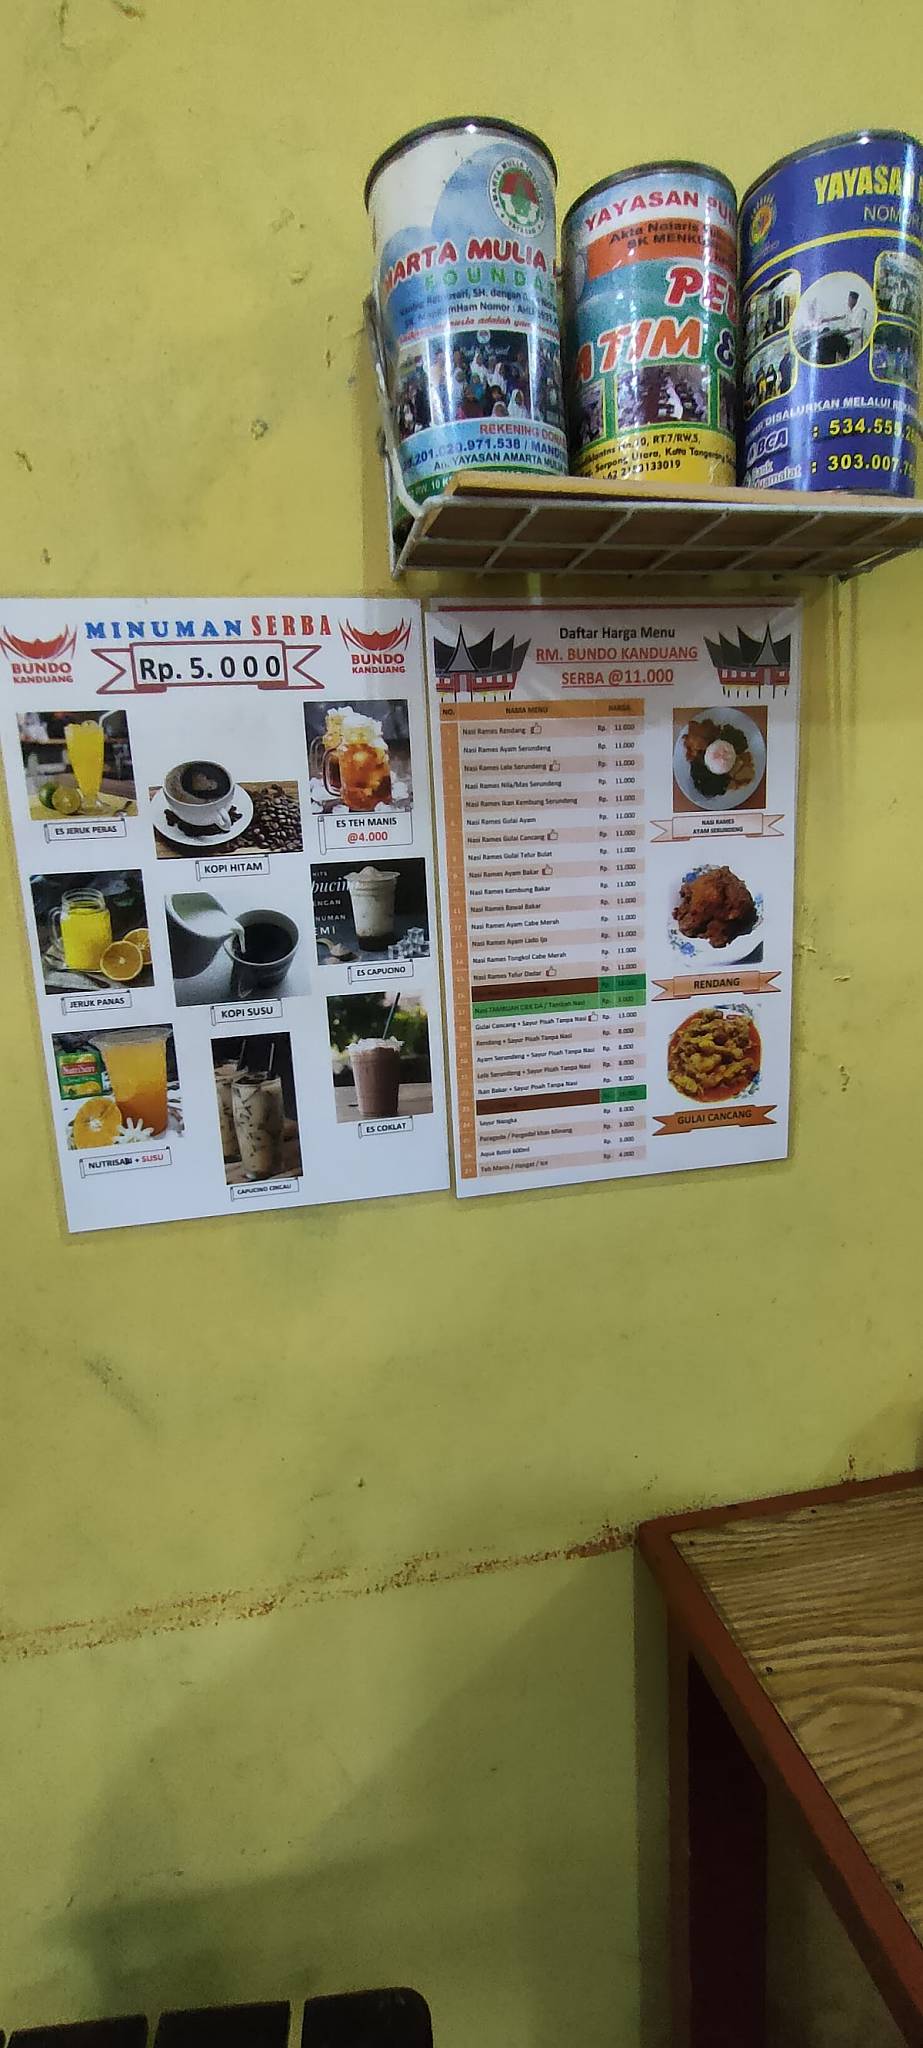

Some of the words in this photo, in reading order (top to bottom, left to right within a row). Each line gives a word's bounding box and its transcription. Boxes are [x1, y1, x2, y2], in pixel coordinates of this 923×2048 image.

[814, 166, 914, 204] YAYASA
[585, 190, 699, 231] YAYASAN
[610, 225, 643, 244] Akta
[648, 222, 699, 232] Notaris
[468, 238, 546, 272] MULIA
[480, 302, 510, 311] Nomor
[765, 399, 840, 428] DISALURKAN
[843, 397, 891, 407] MELALUI
[480, 424, 540, 437] REKENING
[757, 427, 788, 456] BCA
[452, 452, 500, 464] YAYASAN
[503, 453, 542, 464] AMARTA
[85, 619, 243, 639] MINUMAN
[251, 615, 332, 637] SERBA
[559, 627, 599, 639] Daftar
[602, 627, 637, 640] Harga
[640, 627, 675, 639] Menu
[352, 653, 405, 665] BUNDO
[536, 649, 562, 660] RM.
[568, 648, 618, 659] BUNDO
[621, 647, 698, 659] KANDUANG
[12, 662, 72, 674] BUNDO
[140, 657, 182, 683] Rp.
[352, 665, 406, 674] KANDUANG
[13, 674, 74, 684] KANDUANG
[561, 672, 604, 685] SERBA
[608, 669, 673, 684] @11.000
[442, 708, 455, 716] NO.
[500, 727, 526, 735] Rendang
[336, 820, 347, 828] ES
[348, 819, 365, 828] TEH
[367, 817, 397, 827] MANIS
[55, 827, 66, 836] ES
[66, 826, 95, 835] JERUK
[97, 824, 117, 834] PERAS
[346, 831, 389, 844] @4.000
[204, 863, 228, 874] KOPI
[230, 861, 263, 872] HITAM
[367, 967, 405, 975] CAPUCINO
[693, 977, 740, 989] RENDANG
[69, 997, 94, 1008] JERUK
[96, 996, 125, 1006] PANAS
[221, 1008, 244, 1018] KOPI
[246, 1006, 274, 1016] SUSU
[677, 1112, 706, 1125] GULAI
[708, 1109, 752, 1122] CANCANG
[366, 1124, 376, 1133] ES
[377, 1122, 407, 1132] COKLAT
[141, 1153, 164, 1163] SUSU
